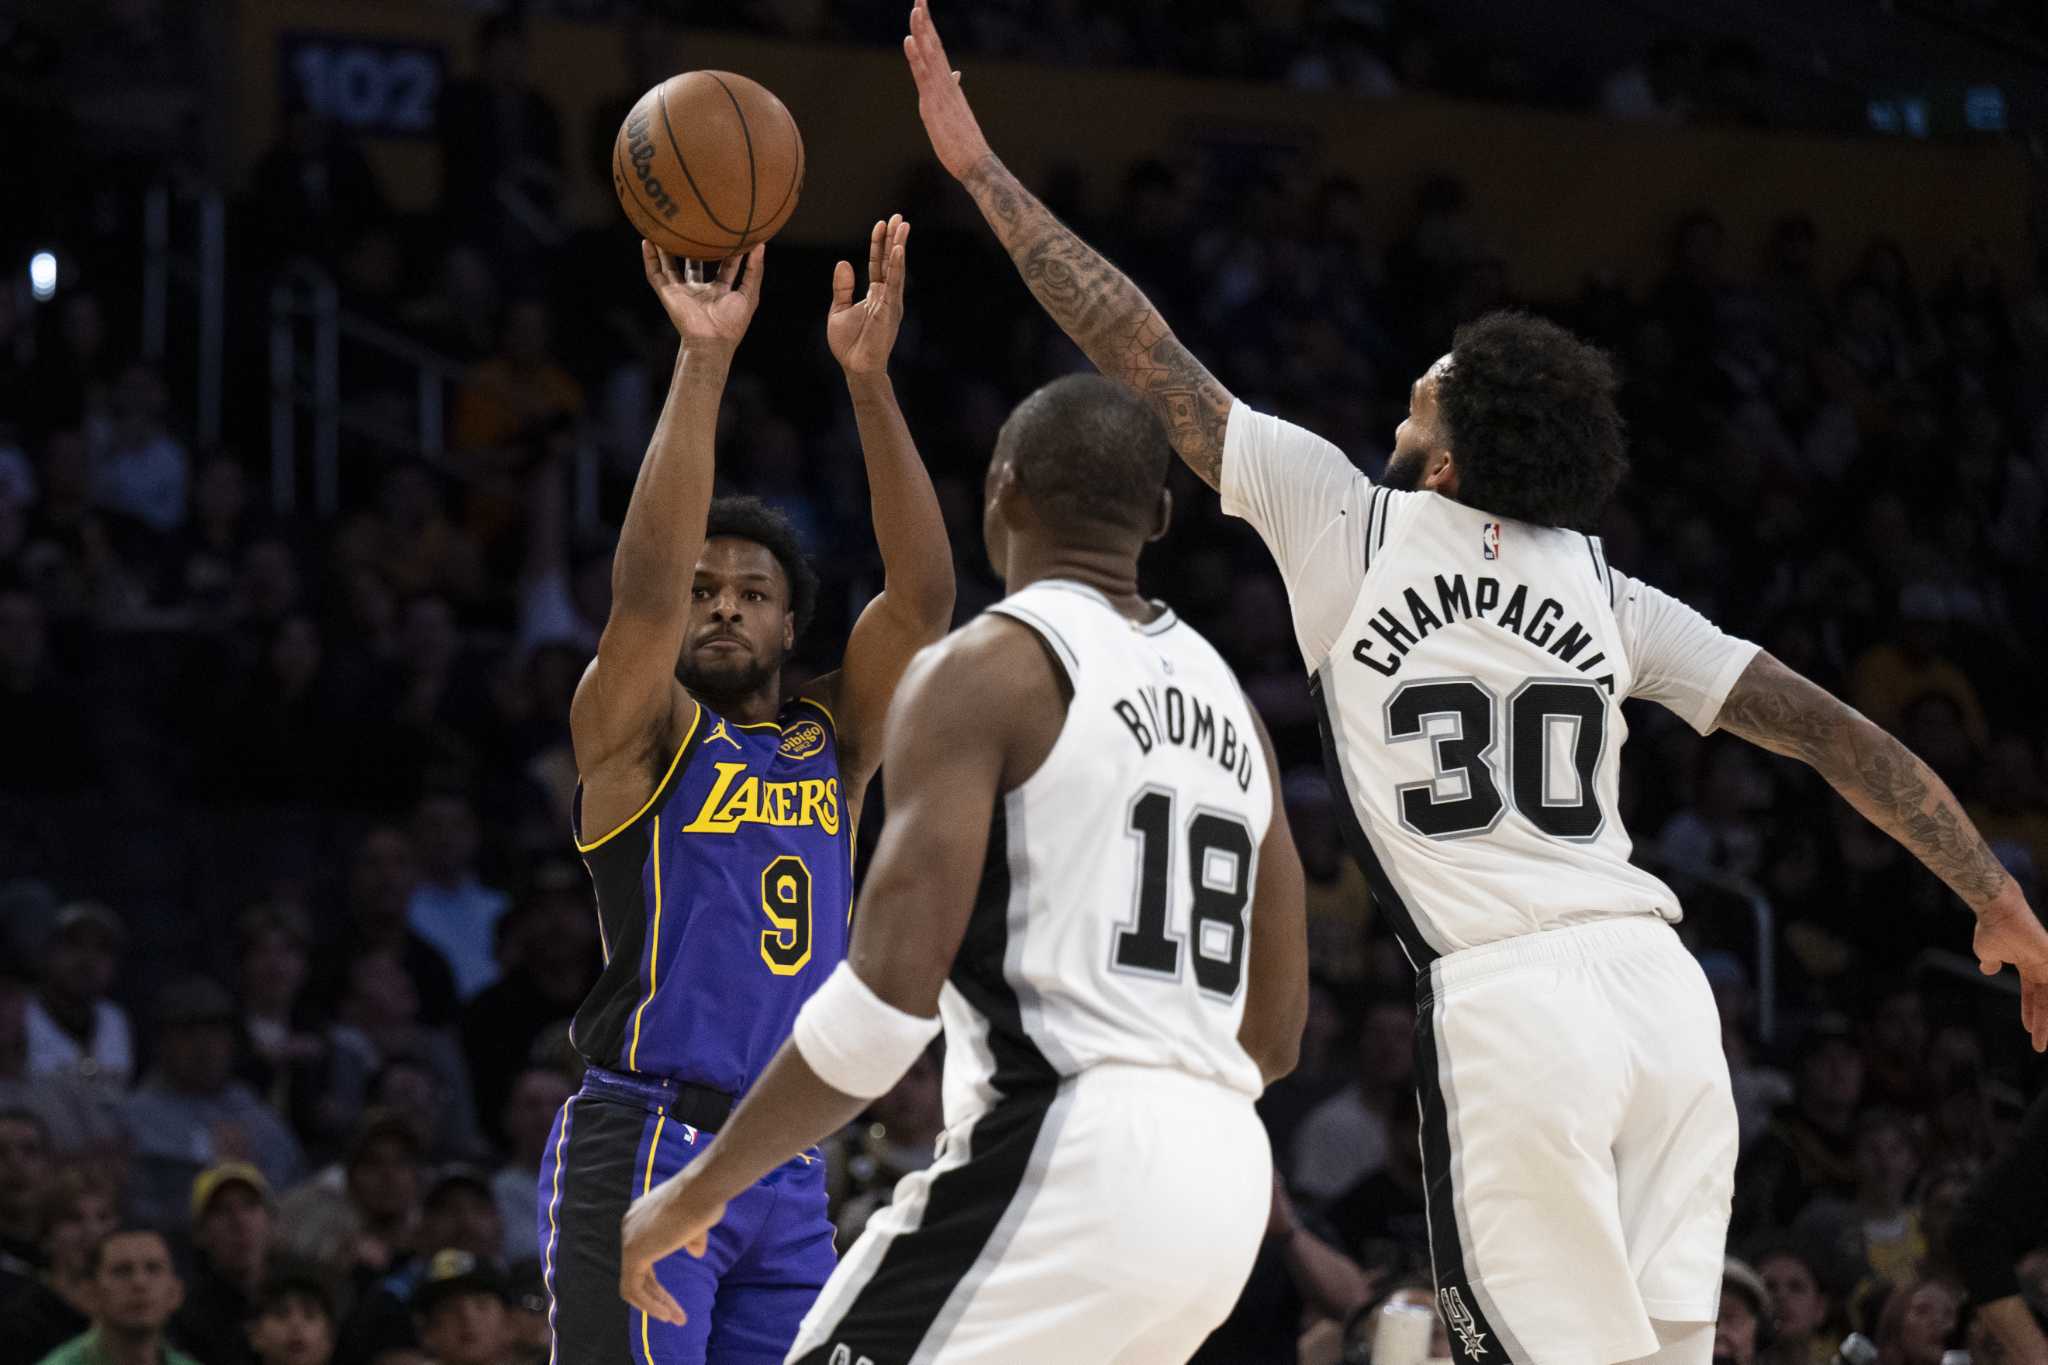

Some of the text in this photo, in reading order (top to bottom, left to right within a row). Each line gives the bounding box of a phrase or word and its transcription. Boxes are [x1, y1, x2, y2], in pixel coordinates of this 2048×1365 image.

[627, 114, 678, 218] Wilson
[1382, 675, 1610, 845] 30
[760, 855, 812, 976] 9
[1106, 781, 1260, 1007] 18
